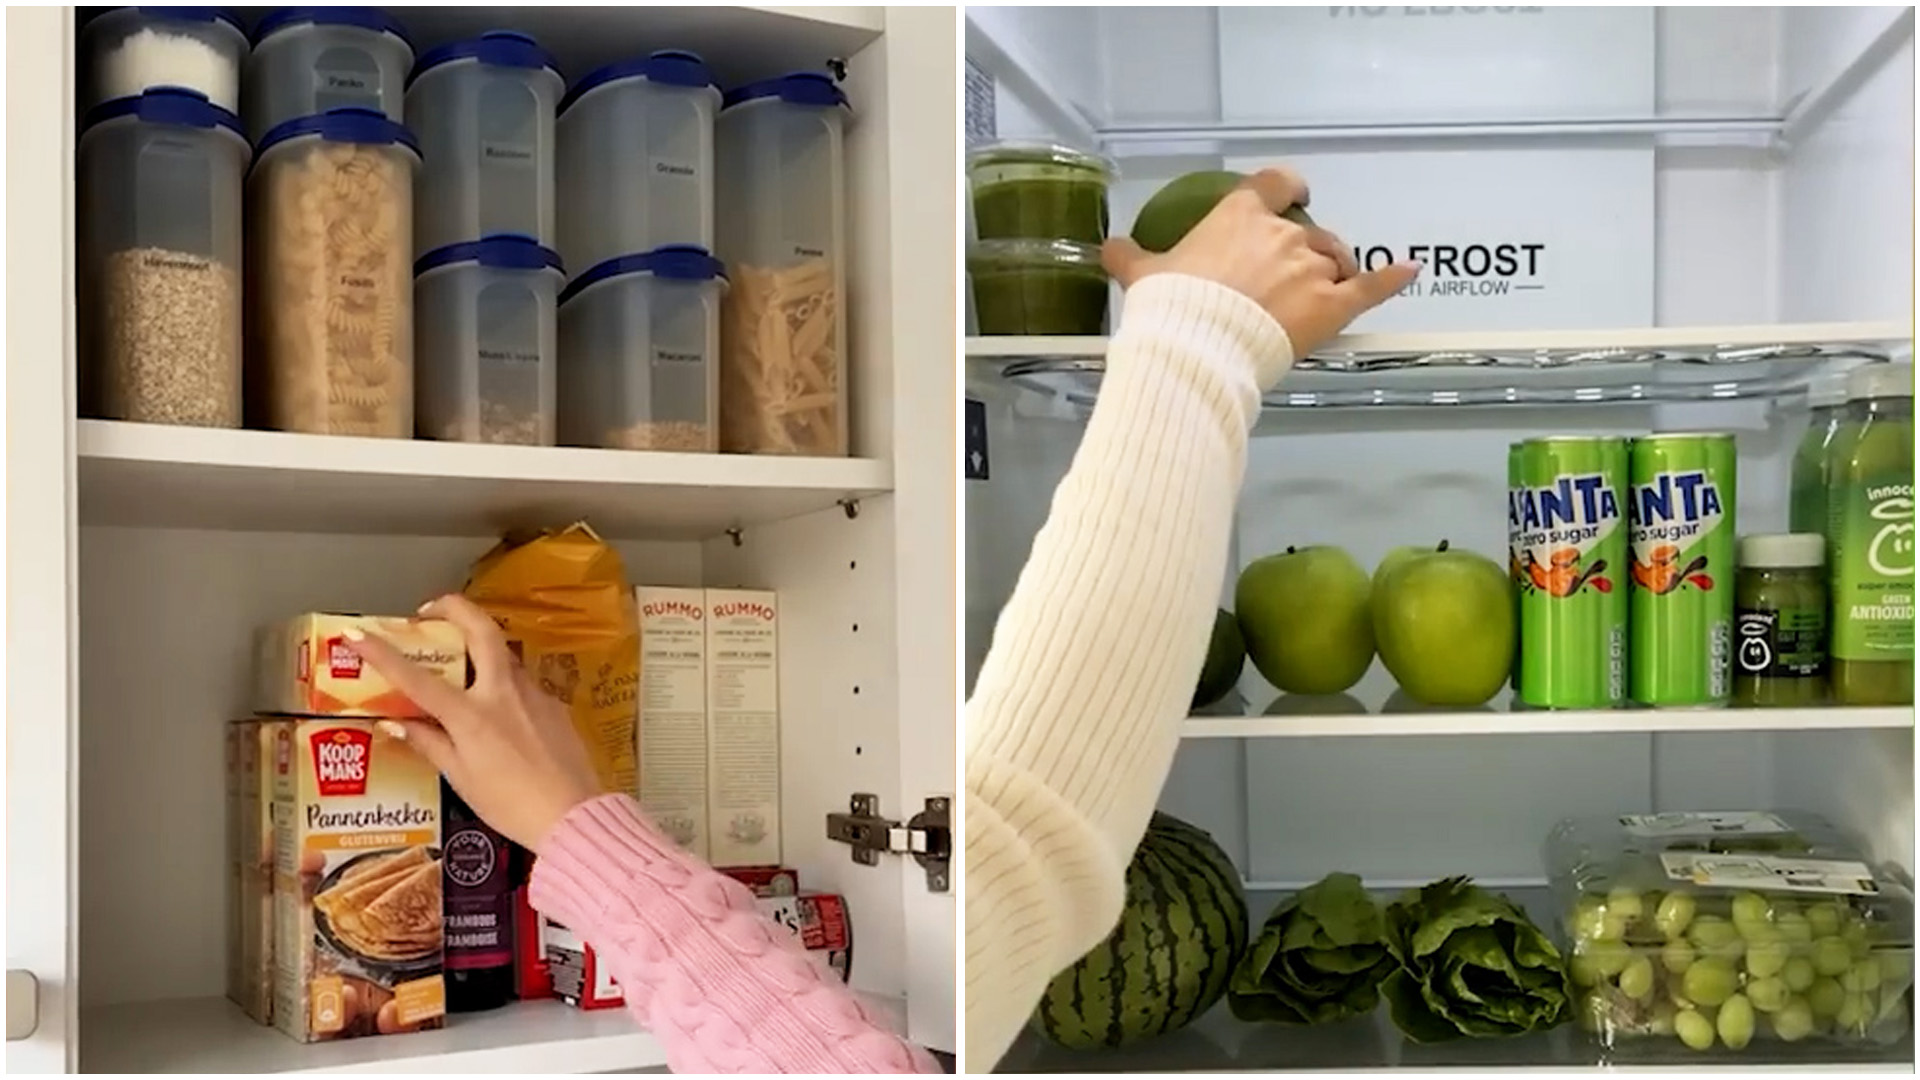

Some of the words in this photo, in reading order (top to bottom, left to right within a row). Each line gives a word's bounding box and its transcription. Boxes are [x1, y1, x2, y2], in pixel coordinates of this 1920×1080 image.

[1409, 244, 1545, 277] FROST
[1430, 280, 1510, 298] AIRFLOW
[1549, 526, 1598, 545] sugar
[1649, 523, 1699, 541] sugar
[643, 602, 703, 621] RUMMO
[714, 602, 775, 621] RUMMO
[319, 743, 365, 763] KOOP
[320, 761, 365, 782] MANS
[307, 802, 436, 829] Pannenkoeken
[339, 832, 407, 847] GLUTENVRIJ
[450, 861, 489, 881] NATURE
